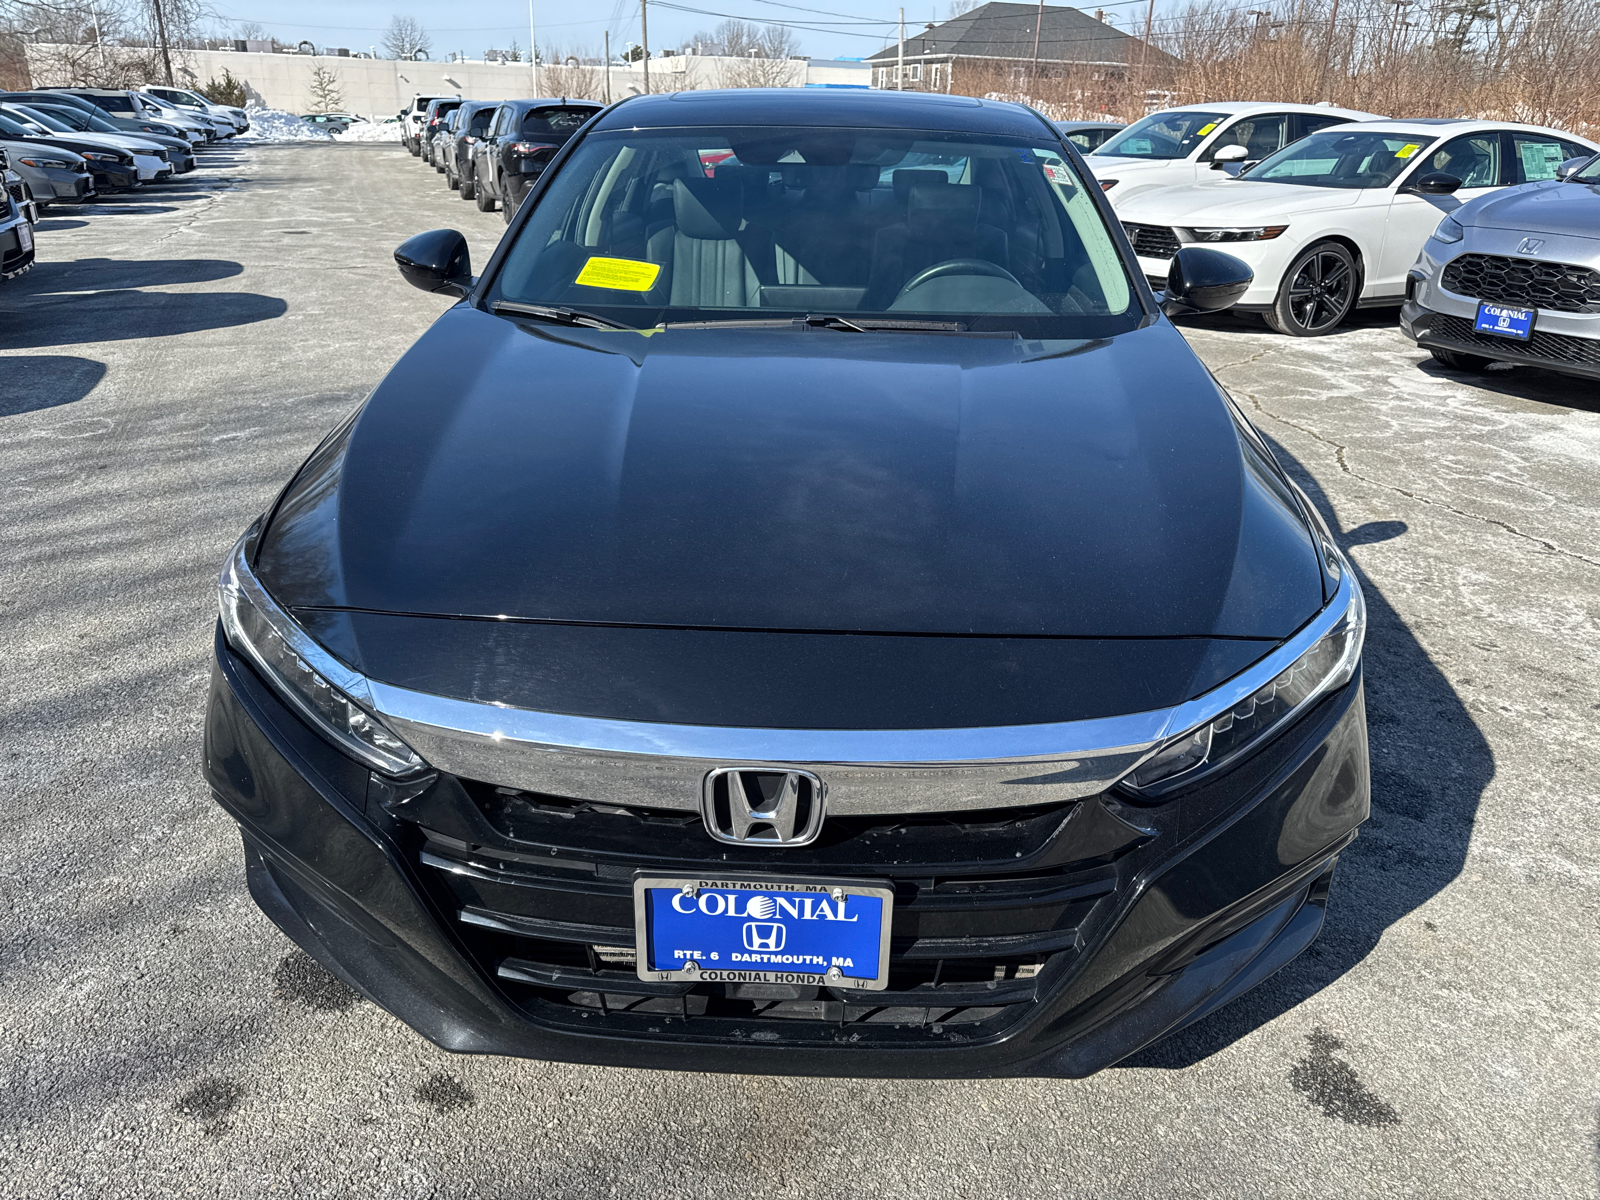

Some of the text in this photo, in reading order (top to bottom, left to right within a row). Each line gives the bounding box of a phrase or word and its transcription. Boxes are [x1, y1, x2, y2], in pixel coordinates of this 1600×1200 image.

[699, 881, 800, 892] DARTMOUTH,
[671, 890, 859, 922] COLONIAL
[674, 949, 854, 967] RTE. 6 DARTMOUTH, MA
[699, 971, 826, 985] COLONIAL HONDA
